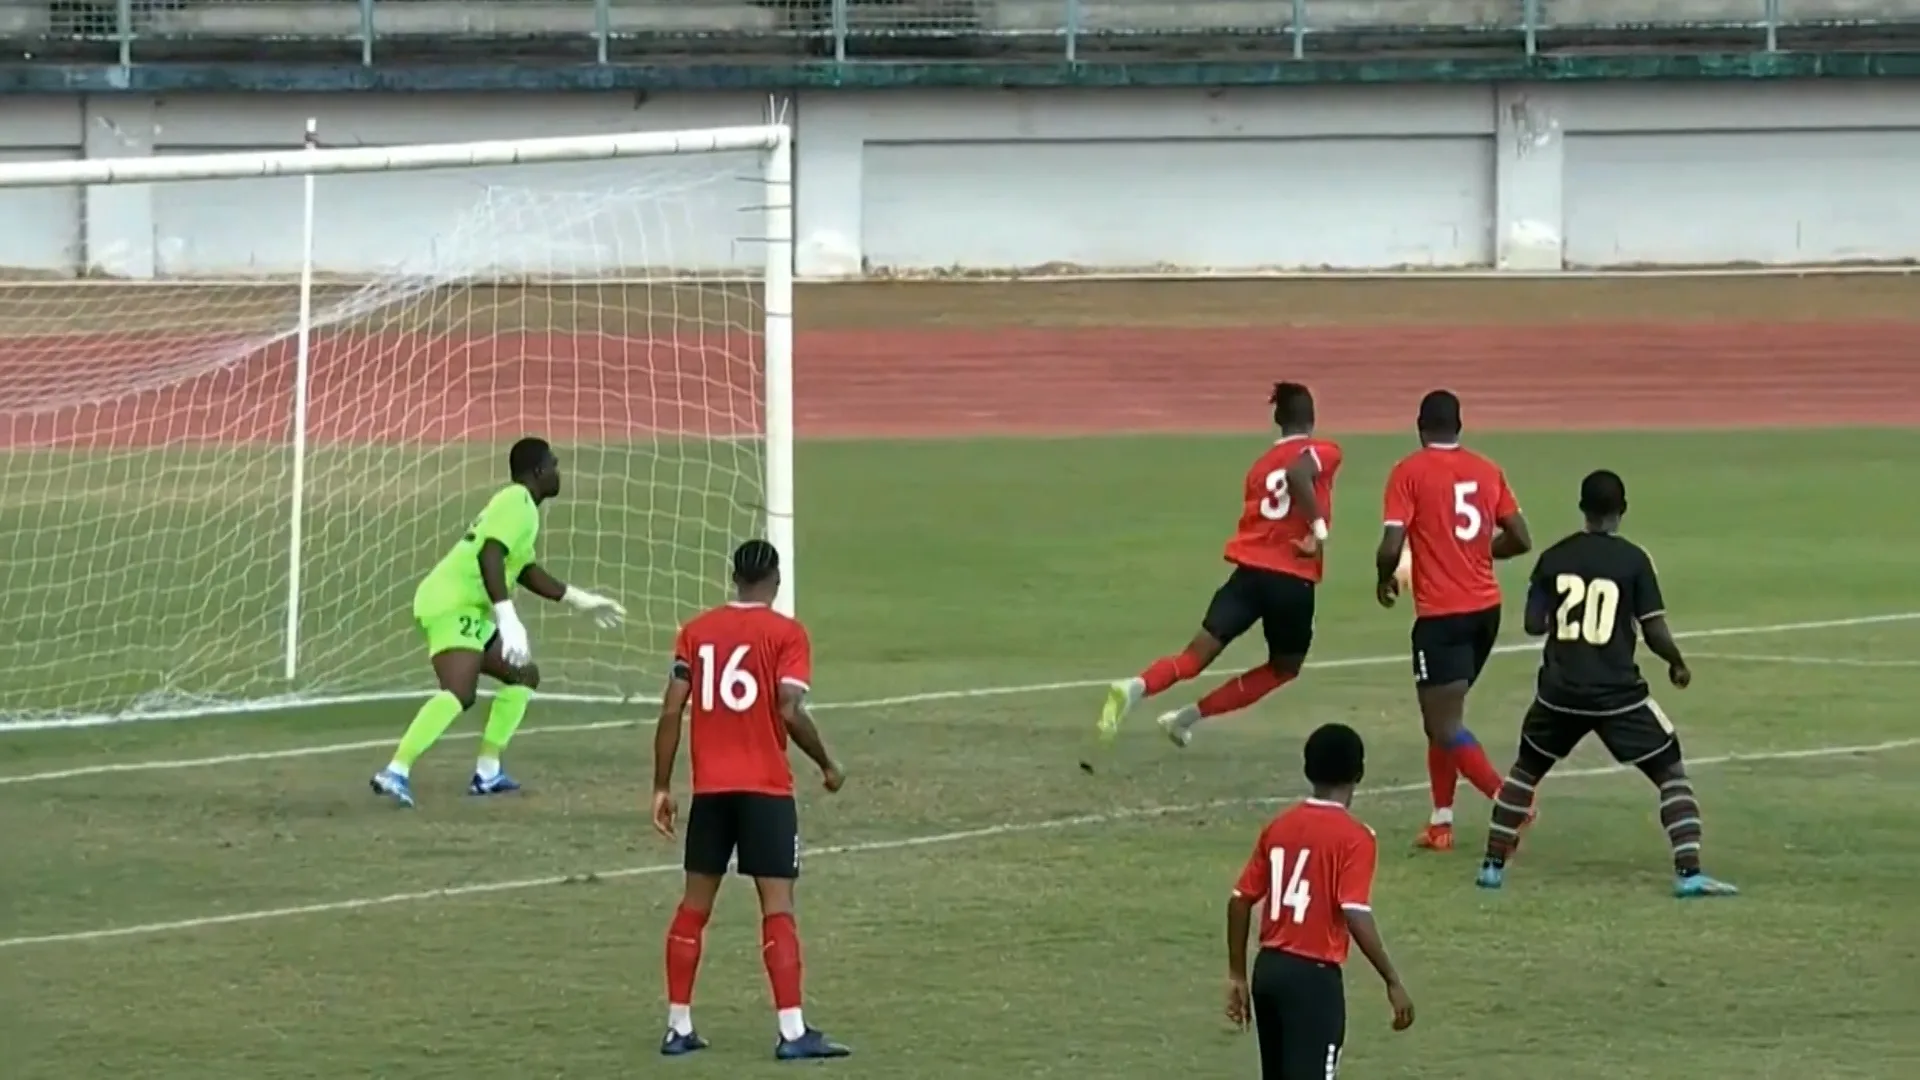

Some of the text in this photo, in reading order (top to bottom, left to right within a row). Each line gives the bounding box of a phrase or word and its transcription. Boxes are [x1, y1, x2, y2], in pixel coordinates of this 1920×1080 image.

[1260, 468, 1291, 520] 3
[1454, 481, 1481, 541] 5
[1556, 573, 1619, 644] 20
[698, 645, 758, 712] 16
[1270, 847, 1311, 924] 14
